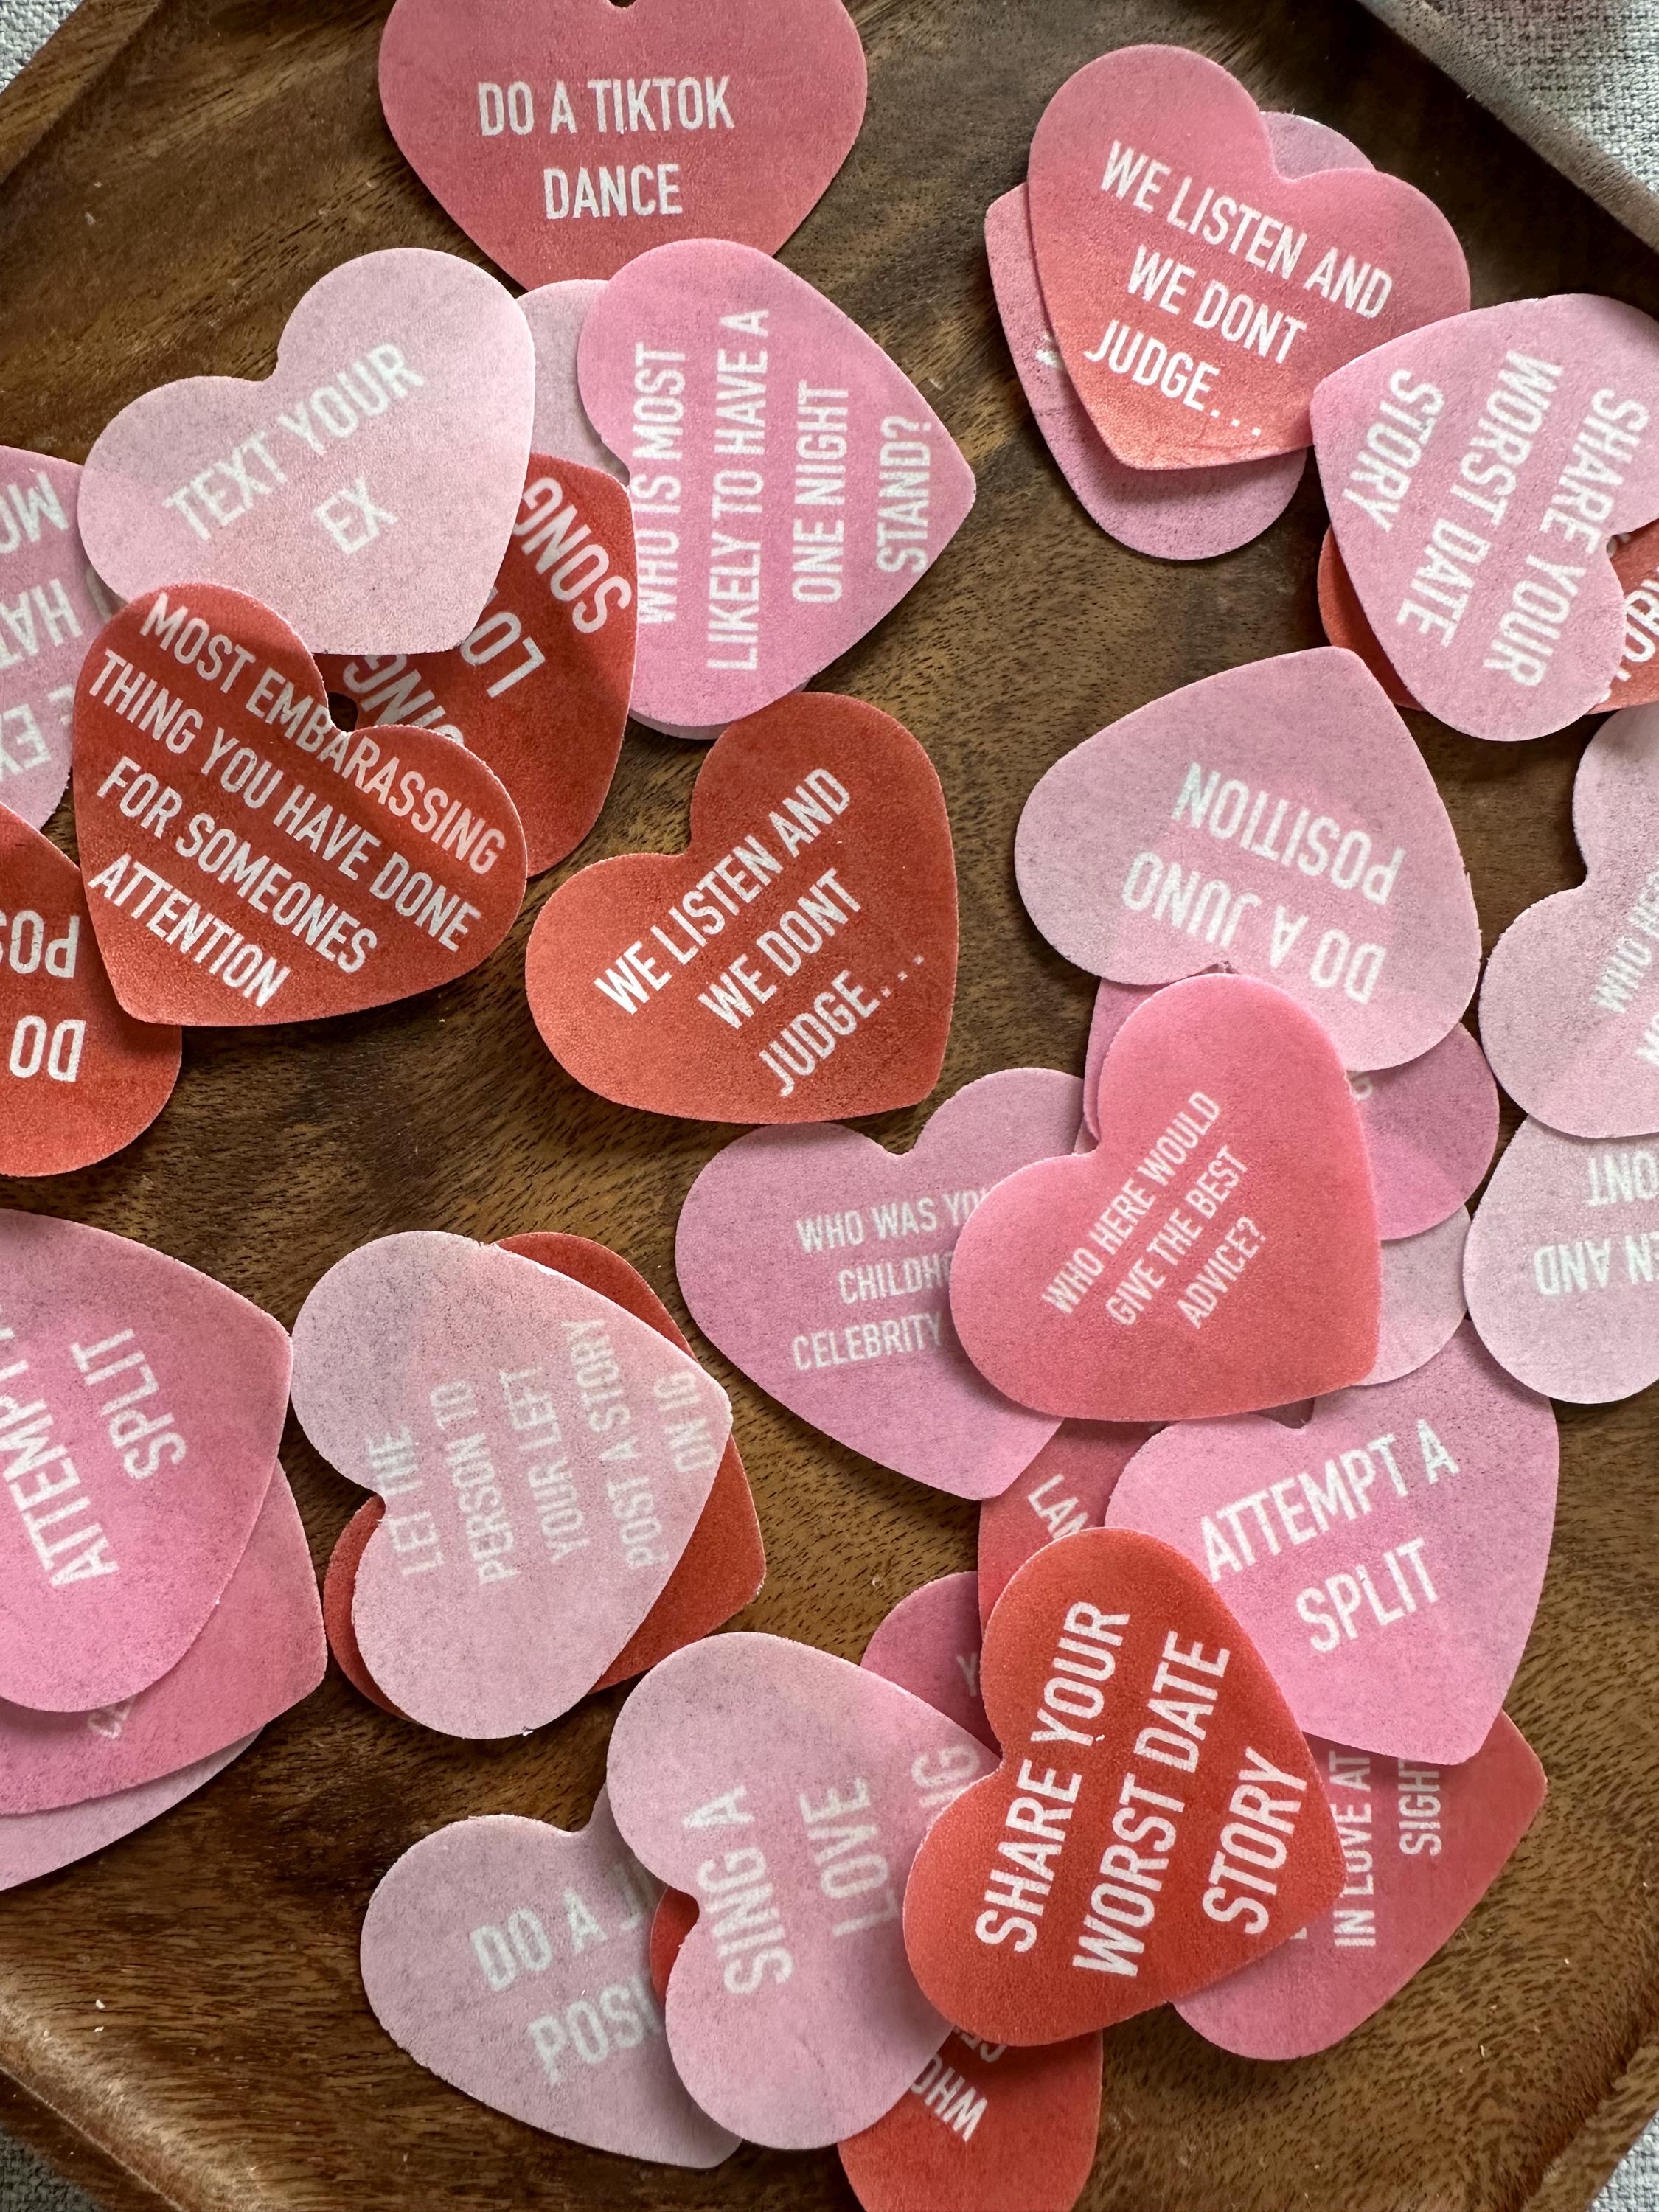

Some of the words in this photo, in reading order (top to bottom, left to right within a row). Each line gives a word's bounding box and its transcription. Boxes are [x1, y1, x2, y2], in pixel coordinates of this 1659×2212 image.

[477, 81, 533, 136] DO
[550, 80, 578, 133] A
[588, 75, 734, 133] TIKTOK
[543, 164, 682, 220] DANCE
[1099, 141, 1171, 213] WE
[1169, 176, 1307, 280] LISTEN
[1304, 248, 1393, 319] AND
[721, 310, 769, 336] A
[1127, 246, 1196, 316] WE
[1192, 282, 1307, 365] DONT
[162, 428, 288, 542] TEXT
[277, 343, 425, 456] YOUR
[633, 344, 686, 460] MOST
[714, 349, 768, 455] HAVE
[796, 380, 849, 509] NIGHT
[1342, 370, 1444, 532] STORY
[1450, 349, 1563, 528] WORST
[312, 476, 399, 554] EX
[630, 474, 682, 516] IS
[714, 473, 763, 525] TO
[876, 415, 932, 574] STAND?
[1540, 389, 1650, 554] SHARE
[513, 476, 632, 633] SONG
[637, 528, 681, 624] WHO
[708, 525, 761, 671] LIKELY
[791, 520, 844, 605] ONE
[1397, 518, 1492, 647] DATE
[461, 588, 546, 698] LO
[1482, 553, 1587, 687] YOUR
[139, 593, 256, 694] MOST
[246, 667, 505, 874] EMBARASSING
[88, 649, 202, 754] THING
[201, 727, 283, 809] YOU
[273, 785, 380, 880] HAVE
[369, 854, 481, 953] DONE
[1171, 761, 1407, 906] POSITION
[96, 755, 181, 839] FOR
[175, 812, 377, 973] SOMEONES
[594, 941, 672, 1015] WE
[650, 835, 783, 964] LISTEN
[768, 769, 850, 858] AND
[1122, 851, 1262, 949] JUNO
[88, 852, 291, 1008] ATTENTION
[697, 954, 777, 1029] WE
[756, 868, 862, 976] DONT
[1270, 905, 1310, 969] A
[1310, 929, 1387, 1006] DO
[1593, 937, 1652, 1013] WHO
[10, 1015, 86, 1082] DO
[796, 1211, 864, 1253] WHO
[871, 1197, 937, 1240] WAS
[943, 1187, 987, 1226] YO
[1042, 1247, 1105, 1314] WHO
[1088, 1178, 1157, 1256] HERE
[1137, 1091, 1220, 1186] WOULD
[1582, 1150, 1659, 1206] ONT
[1105, 1256, 1166, 1326] GIVE
[1146, 1208, 1203, 1266] THE
[1185, 1144, 1248, 1220] BEST
[1176, 1216, 1267, 1329] ADVICE?
[1534, 1237, 1610, 1296] AND
[562, 1319, 631, 1433] STORY
[653, 1370, 699, 1412] IG
[792, 1310, 942, 1371] CELEBRITY
[71, 1328, 187, 1479] SPLIT
[429, 1381, 479, 1430] TO
[498, 1366, 563, 1452] LEFT
[599, 1435, 643, 1463] A
[663, 1417, 718, 1475] ON
[366, 1426, 422, 1502] THE
[446, 1433, 518, 1585] PERSON
[526, 1458, 588, 1565] YOUR
[1198, 1433, 1410, 1582] ATTEMPT
[1416, 1419, 1460, 1486] A
[388, 1510, 444, 1577] LET
[605, 1475, 669, 1570] POST
[1295, 1539, 1441, 1655] SPLIT
[681, 1785, 757, 1831] A
[975, 1759, 1082, 1953] SHARE
[1031, 1601, 1131, 1747] YOUR
[1071, 1773, 1186, 1978] WORST
[1133, 1631, 1231, 1774] DATE
[1329, 1750, 1371, 1792] AT
[799, 1776, 899, 1937] LOVE
[1203, 1747, 1307, 1934] STORY
[1329, 1803, 1374, 1895] LOVE
[469, 1907, 554, 1993] DO
[563, 1888, 608, 1954] A
[696, 1845, 793, 1995] SING
[1333, 1910, 1376, 1947] IN
